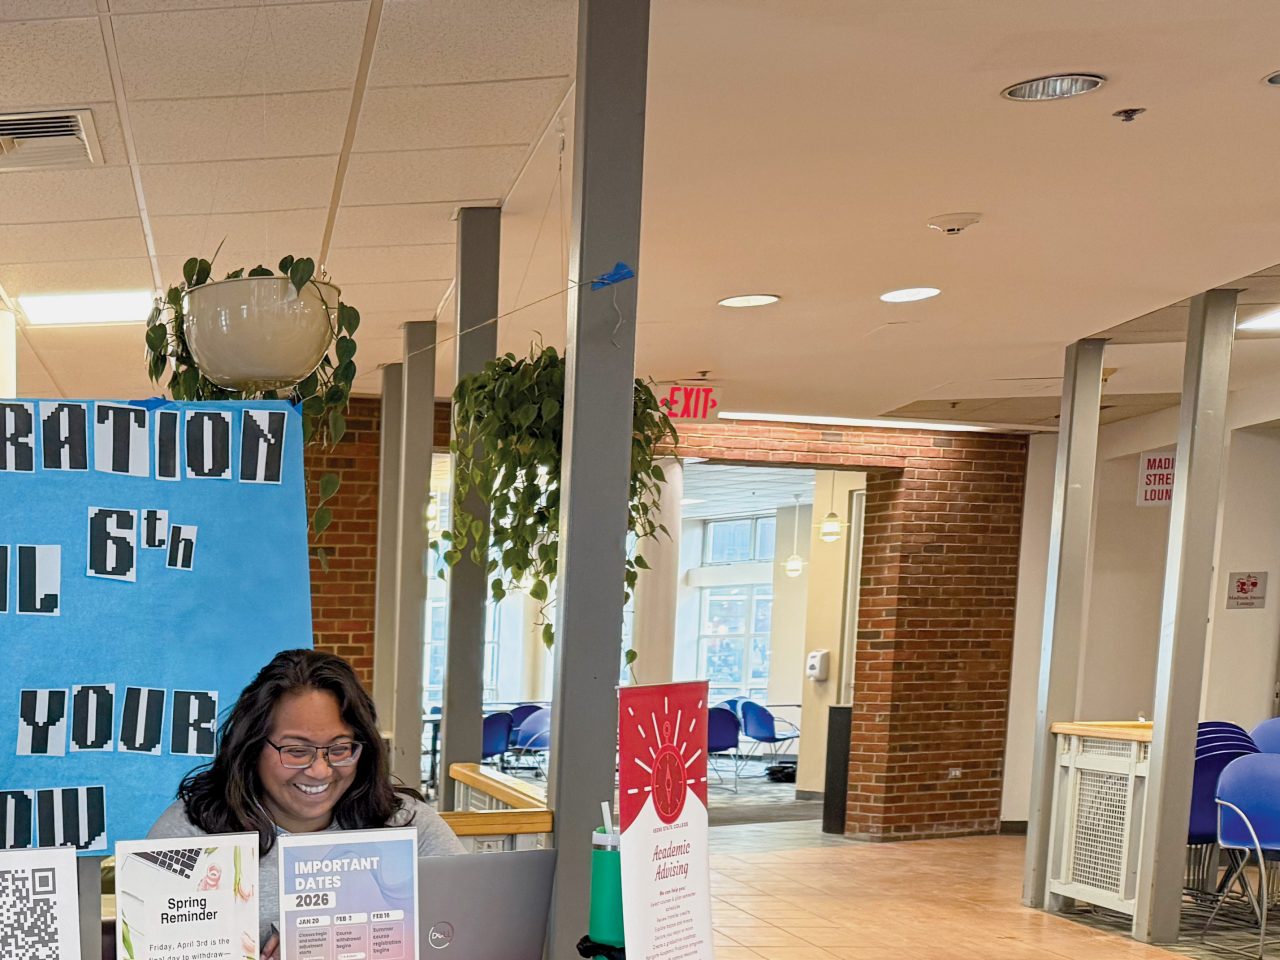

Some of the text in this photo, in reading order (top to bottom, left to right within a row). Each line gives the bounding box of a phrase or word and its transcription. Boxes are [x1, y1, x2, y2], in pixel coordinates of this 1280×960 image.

[667, 387, 713, 419] EXIT
[89, 508, 195, 577] 6th
[20, 685, 216, 755] YOUR
[652, 839, 691, 862] Academic
[294, 857, 380, 874] IMPORTANT
[654, 860, 689, 881] Advising
[295, 875, 342, 890] DATES
[167, 897, 207, 910] Spring
[295, 893, 329, 907] 2026
[161, 909, 218, 924] Reminder
[177, 941, 194, 949] April
[196, 939, 208, 947] 3rd
